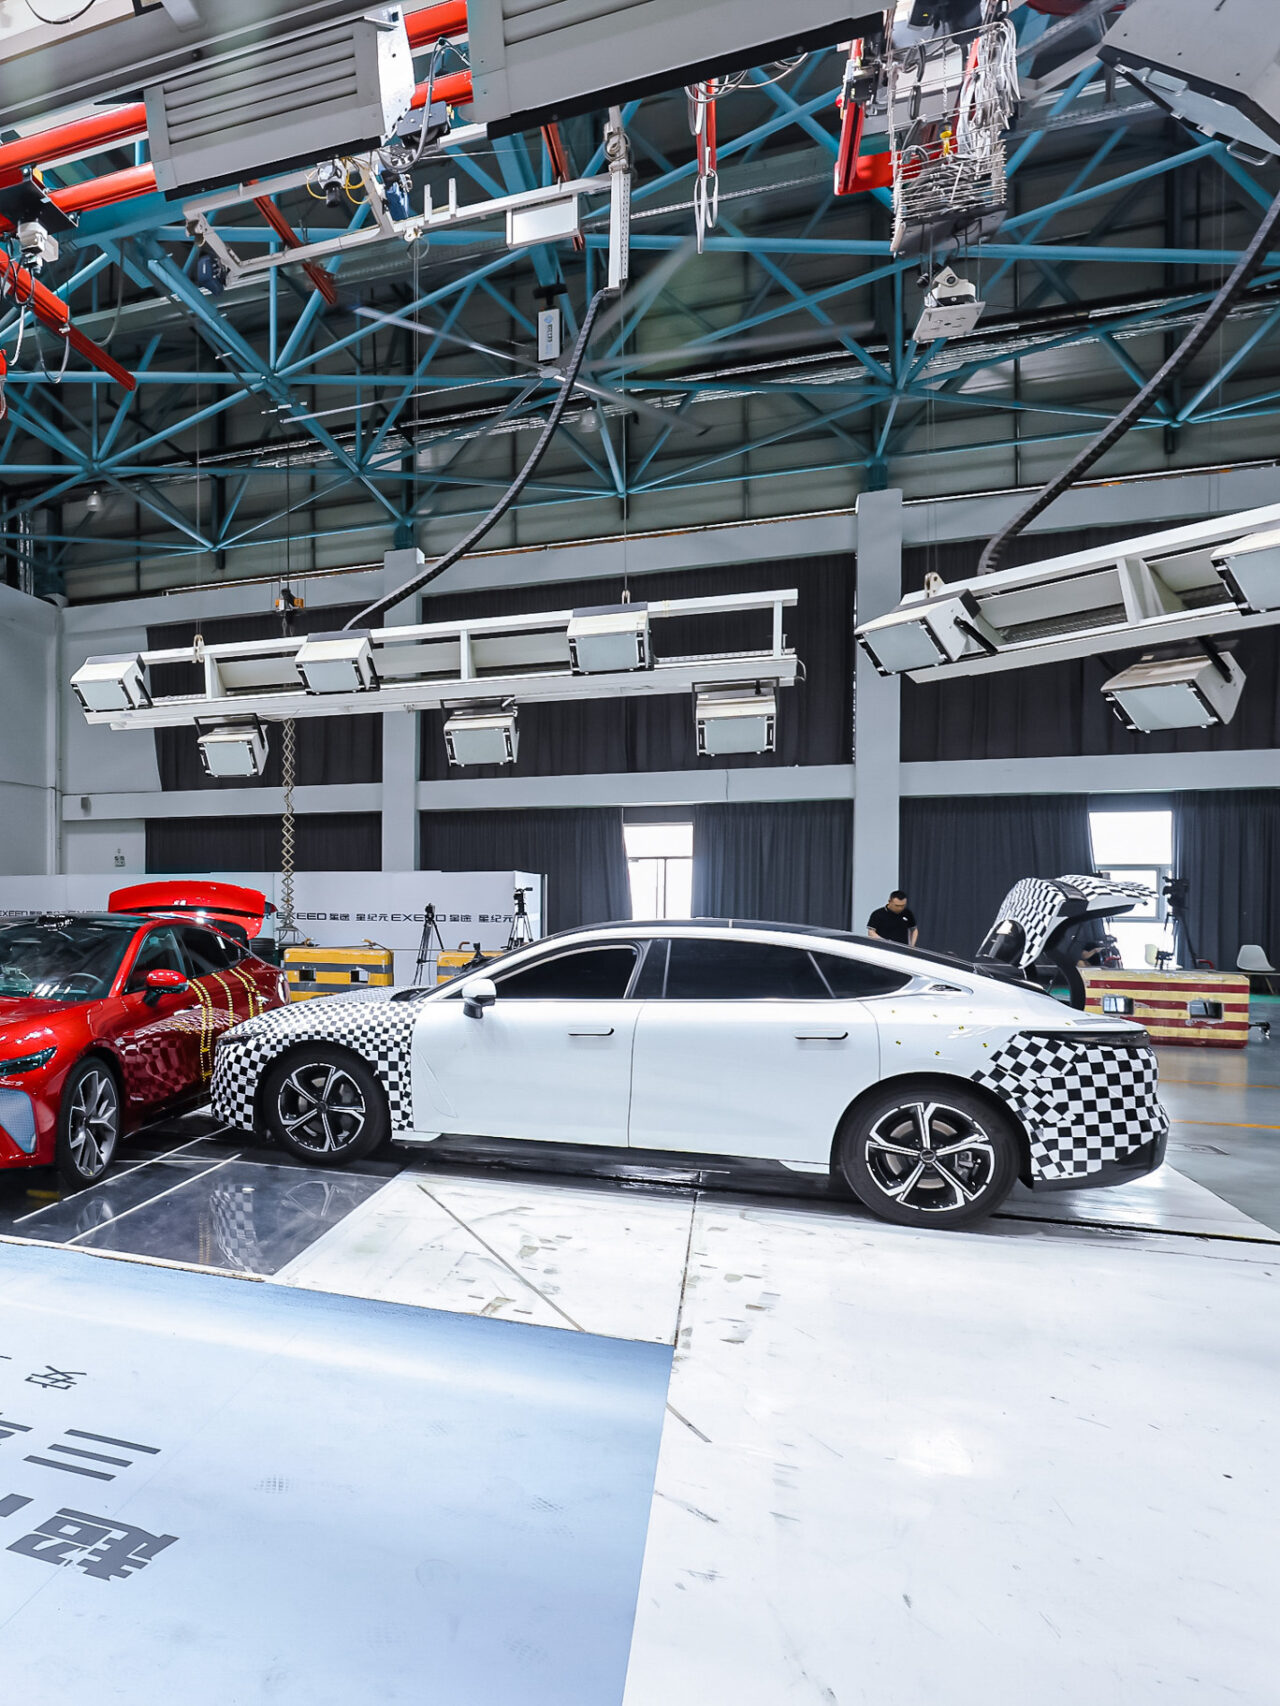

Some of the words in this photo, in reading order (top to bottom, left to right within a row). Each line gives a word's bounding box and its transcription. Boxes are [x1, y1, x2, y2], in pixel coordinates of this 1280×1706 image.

[356, 913, 389, 922] 星纪元
[391, 913, 446, 922] EXED
[478, 914, 514, 923] 星纪元
